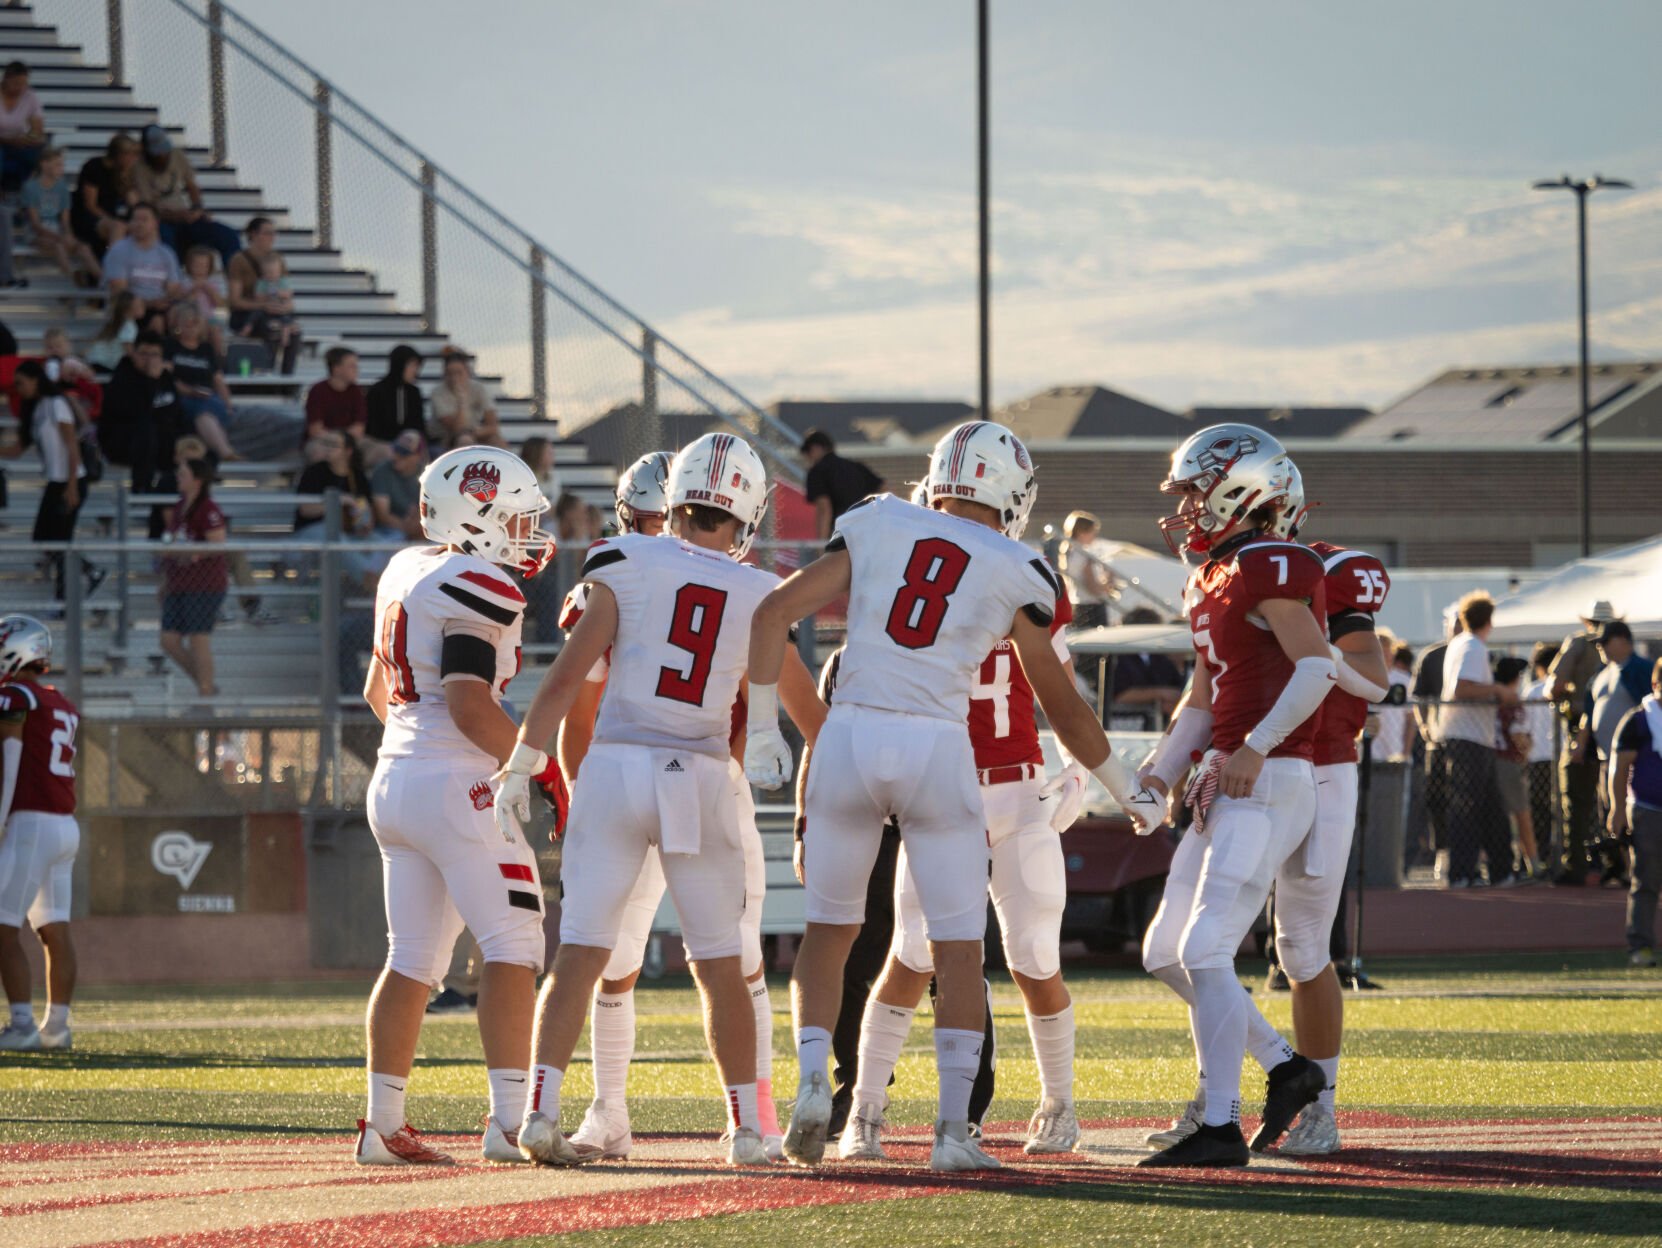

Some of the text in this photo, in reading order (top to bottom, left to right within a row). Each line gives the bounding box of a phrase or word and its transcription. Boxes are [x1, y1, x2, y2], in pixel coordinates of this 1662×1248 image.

[713, 493, 734, 509] OUT
[954, 484, 976, 498] OUT
[1269, 555, 1288, 586] 7
[1353, 569, 1386, 604] 35
[885, 537, 972, 650] 8
[655, 582, 728, 707] 9
[969, 654, 1013, 738] 4
